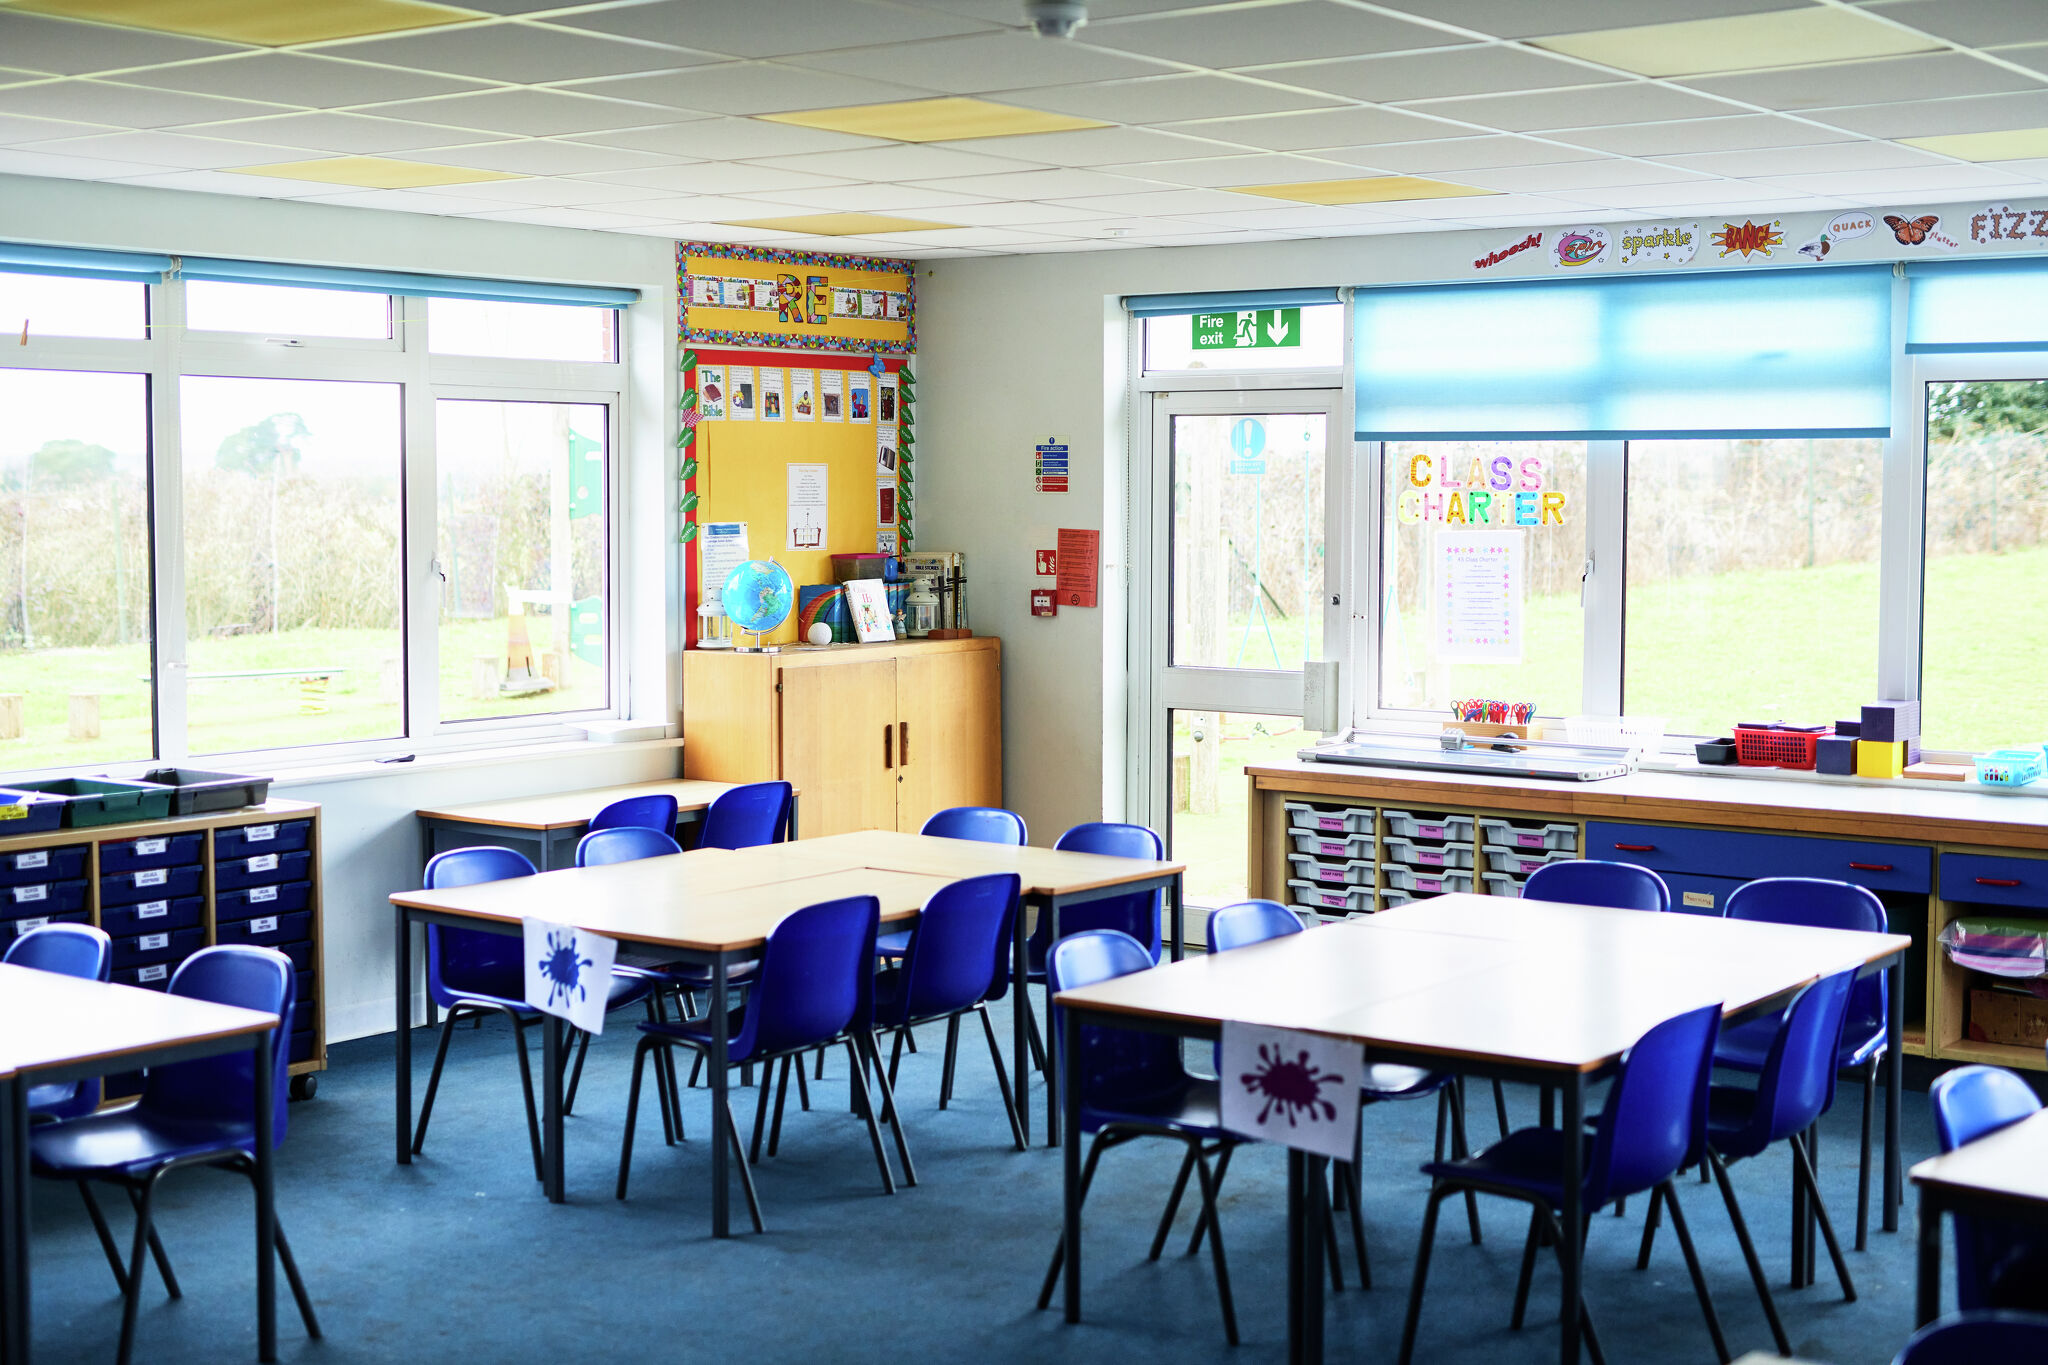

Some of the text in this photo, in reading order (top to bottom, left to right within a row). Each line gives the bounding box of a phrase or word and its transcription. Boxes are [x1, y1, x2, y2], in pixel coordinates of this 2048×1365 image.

[1833, 220, 1871, 232] QUACK
[1971, 210, 2048, 240] FIZZ
[1622, 228, 1692, 256] sparkle
[1725, 225, 1770, 249] BANG!
[1929, 232, 1958, 248] flutter
[1474, 233, 1542, 268] whoosh!
[1565, 240, 1602, 258] spin
[776, 273, 829, 325] RE
[1200, 315, 1223, 328] Fire
[1200, 332, 1223, 345] exit
[702, 370, 721, 382] The
[703, 404, 722, 417] Bible
[1410, 454, 1543, 492] CLASS
[1399, 491, 1566, 525] CHARTER
